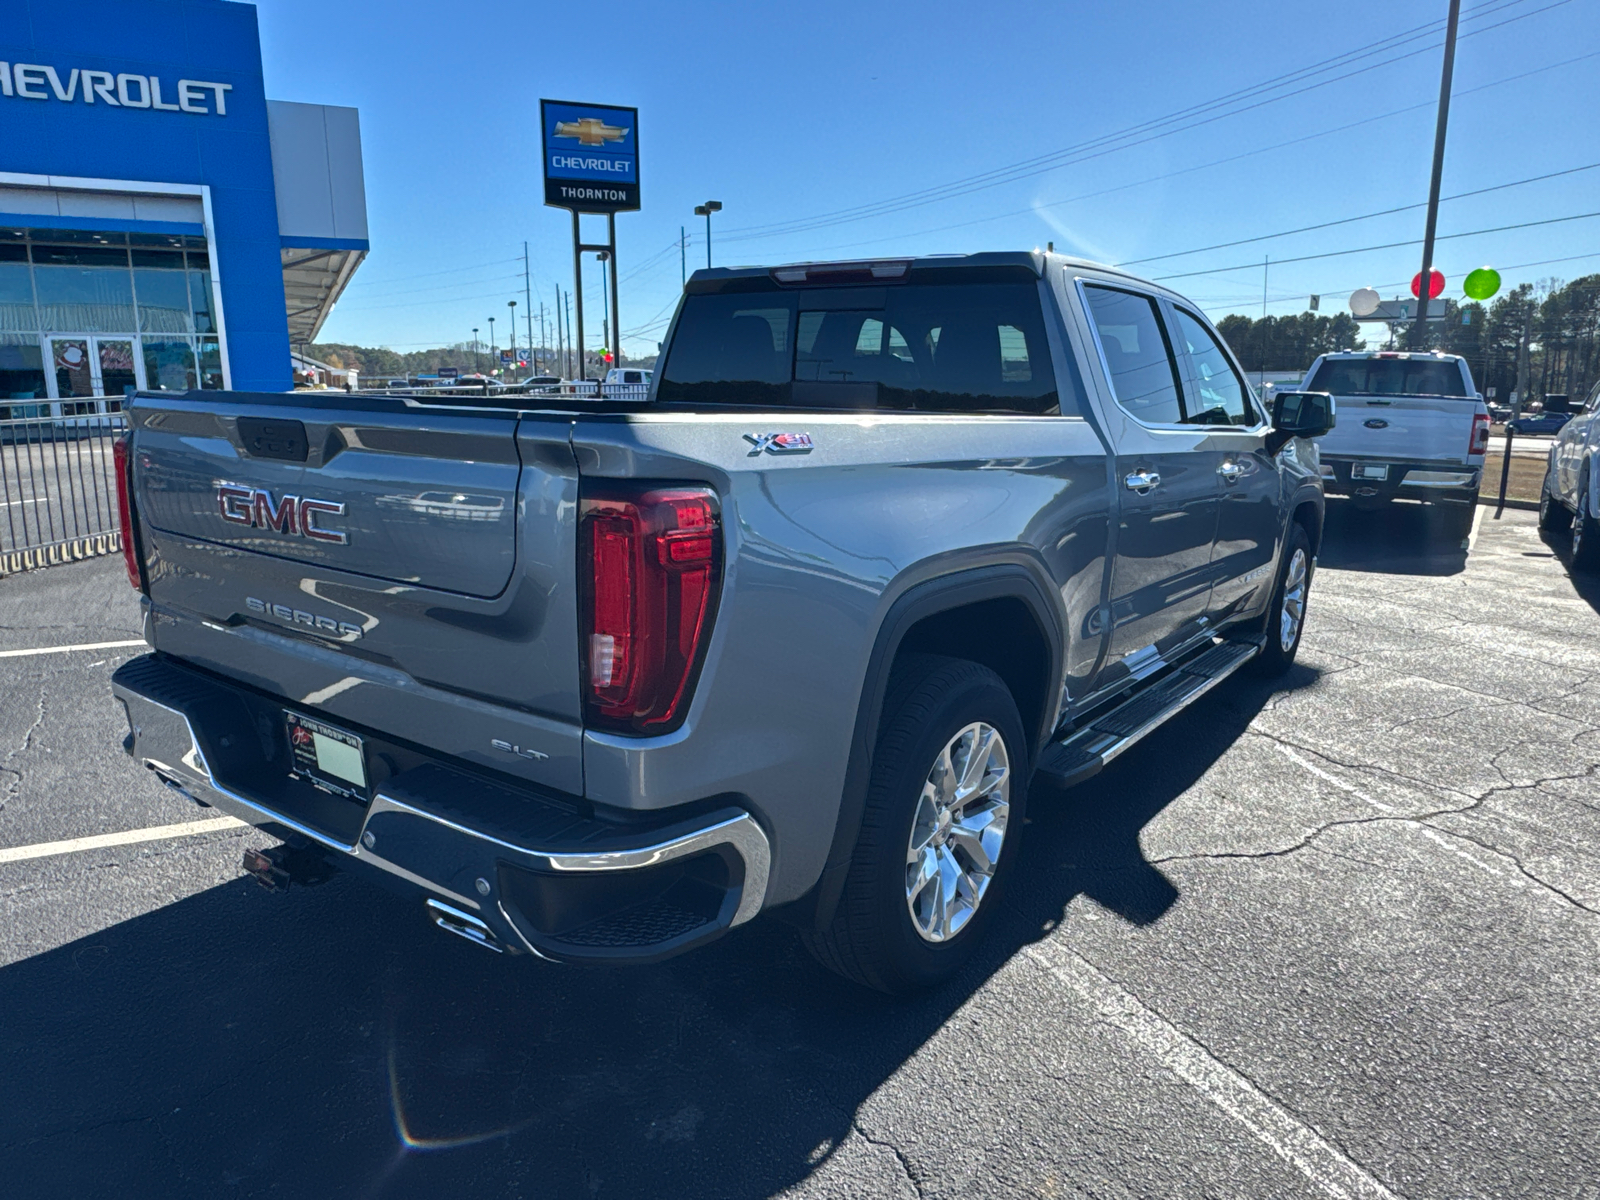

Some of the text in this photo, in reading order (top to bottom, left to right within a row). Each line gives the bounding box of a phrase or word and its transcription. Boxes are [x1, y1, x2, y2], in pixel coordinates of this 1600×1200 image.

[552, 155, 631, 172] CHEVROLET
[560, 186, 627, 201] THORNTON
[217, 483, 348, 545] GMC
[246, 596, 364, 639] SIERRA
[491, 739, 549, 760] SLT
